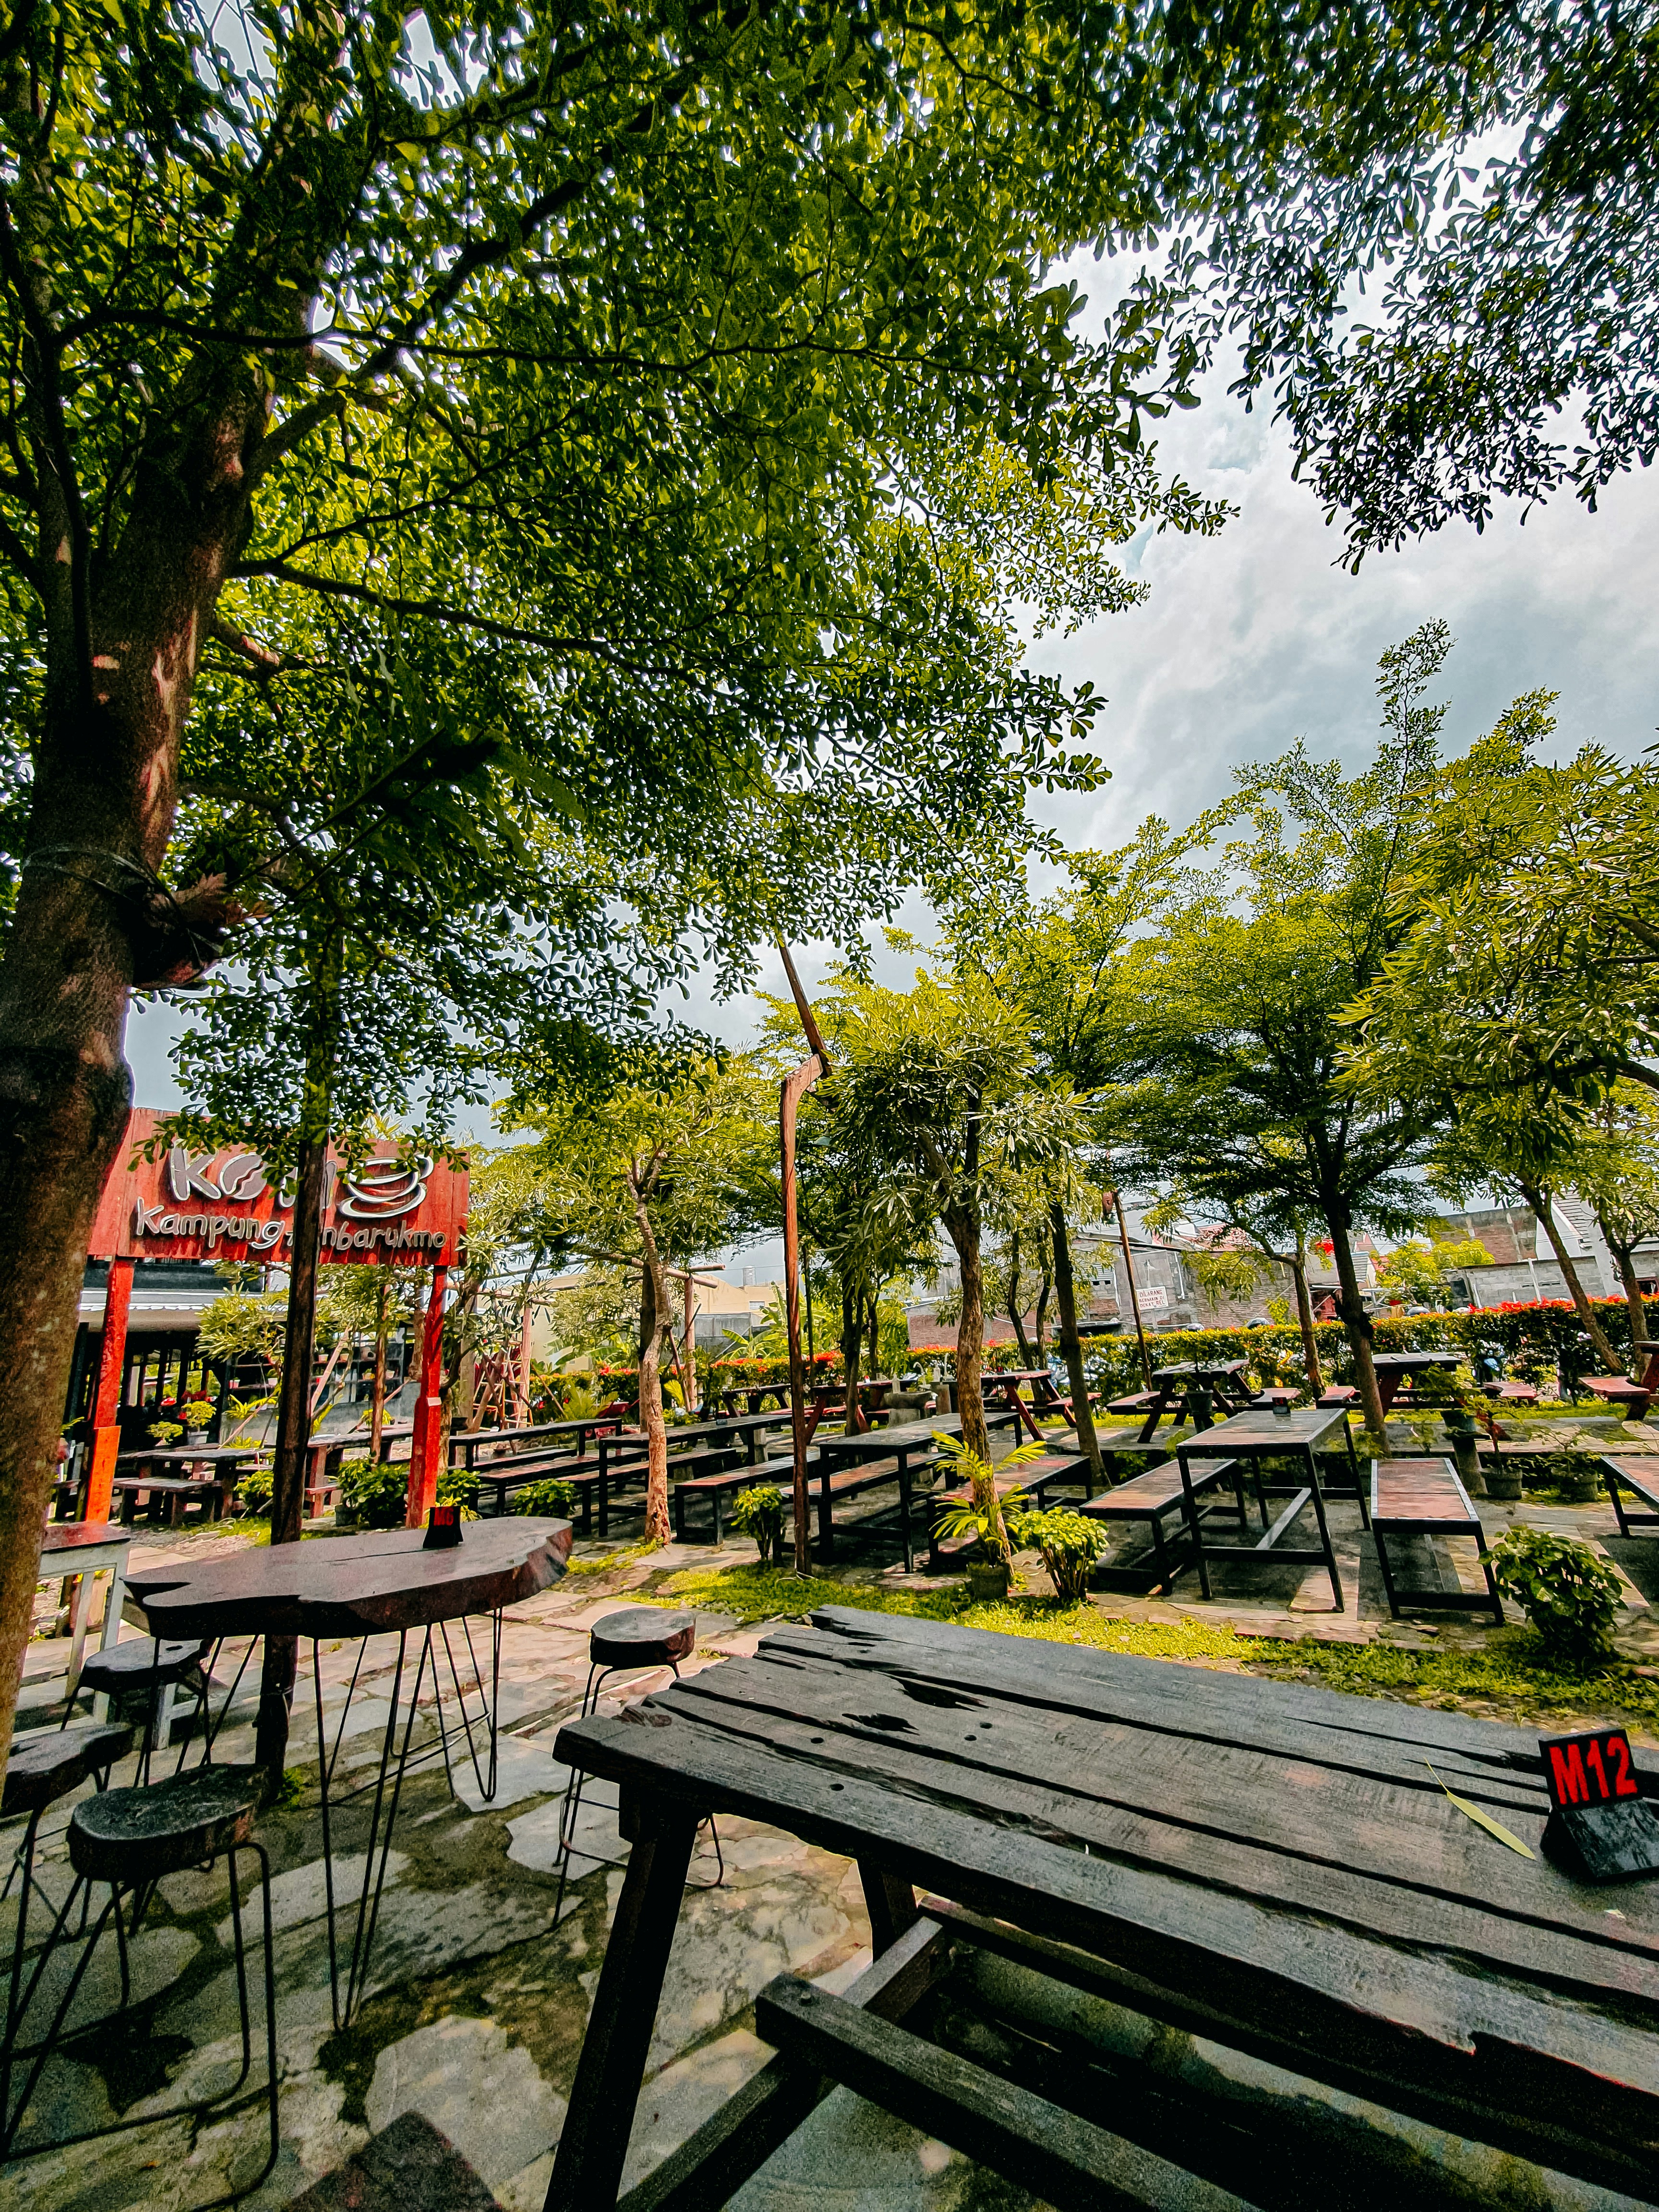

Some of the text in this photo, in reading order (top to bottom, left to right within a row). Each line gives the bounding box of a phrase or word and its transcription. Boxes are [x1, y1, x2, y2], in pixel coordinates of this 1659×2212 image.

[169, 1138, 337, 1209] Koi
[136, 1196, 446, 1250] Kampung mbarukmo
[1549, 1736, 1638, 1805] M12
